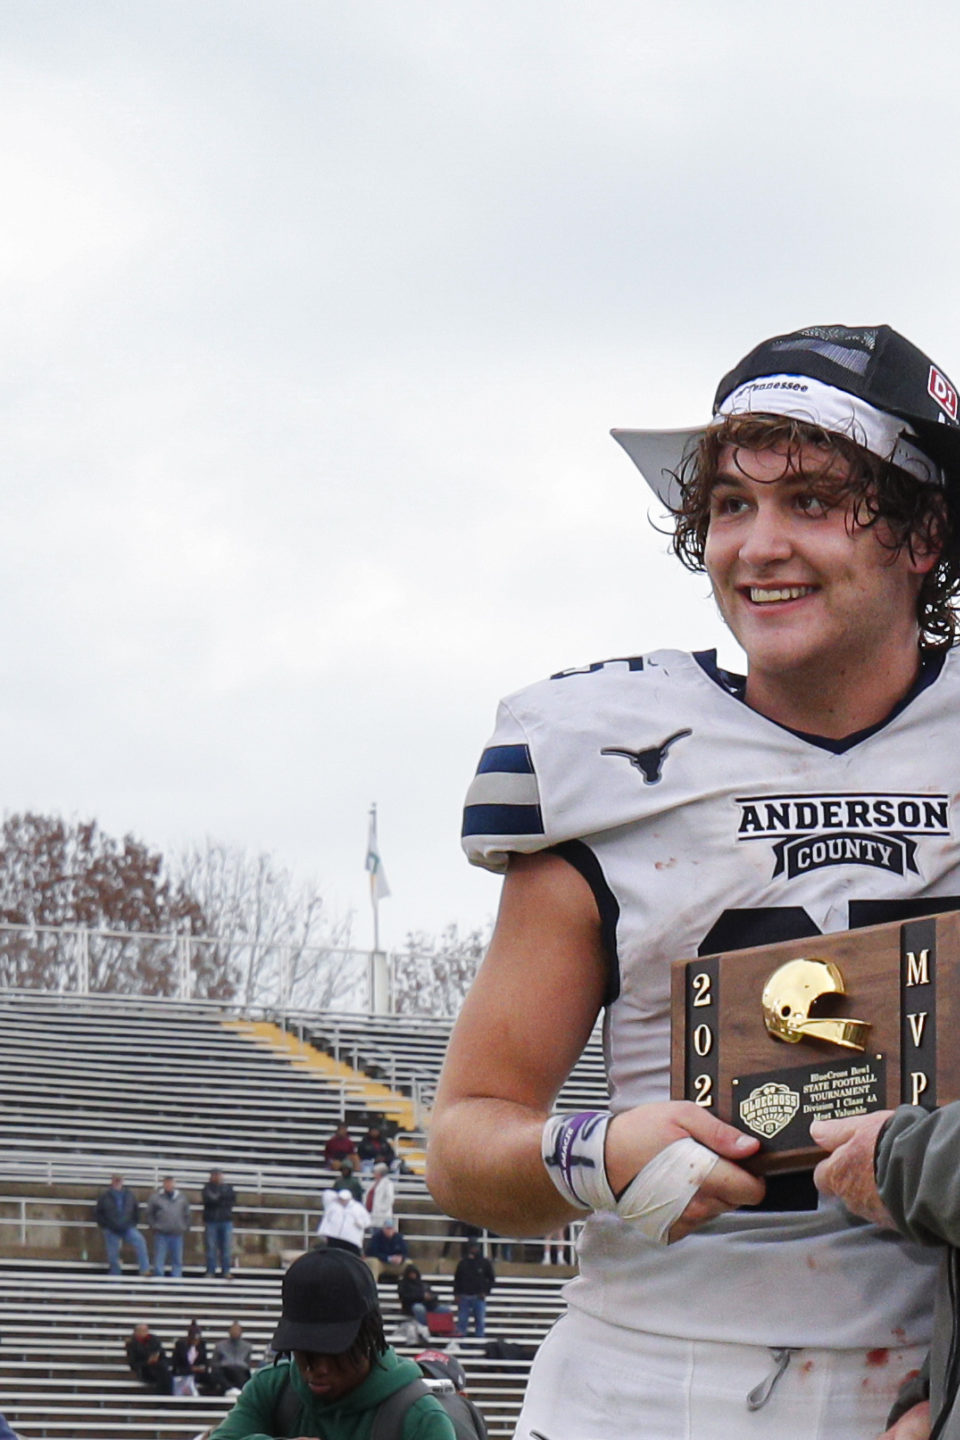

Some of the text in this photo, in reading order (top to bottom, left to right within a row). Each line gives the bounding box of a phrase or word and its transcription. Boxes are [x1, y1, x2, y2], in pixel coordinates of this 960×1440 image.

[934, 374, 954, 411] D1
[738, 800, 948, 833] ANDERSON
[797, 838, 893, 868] COUNTY
[803, 1073, 877, 1093] STATE FOOTBALL
[810, 1085, 870, 1102] TOURNAMENT
